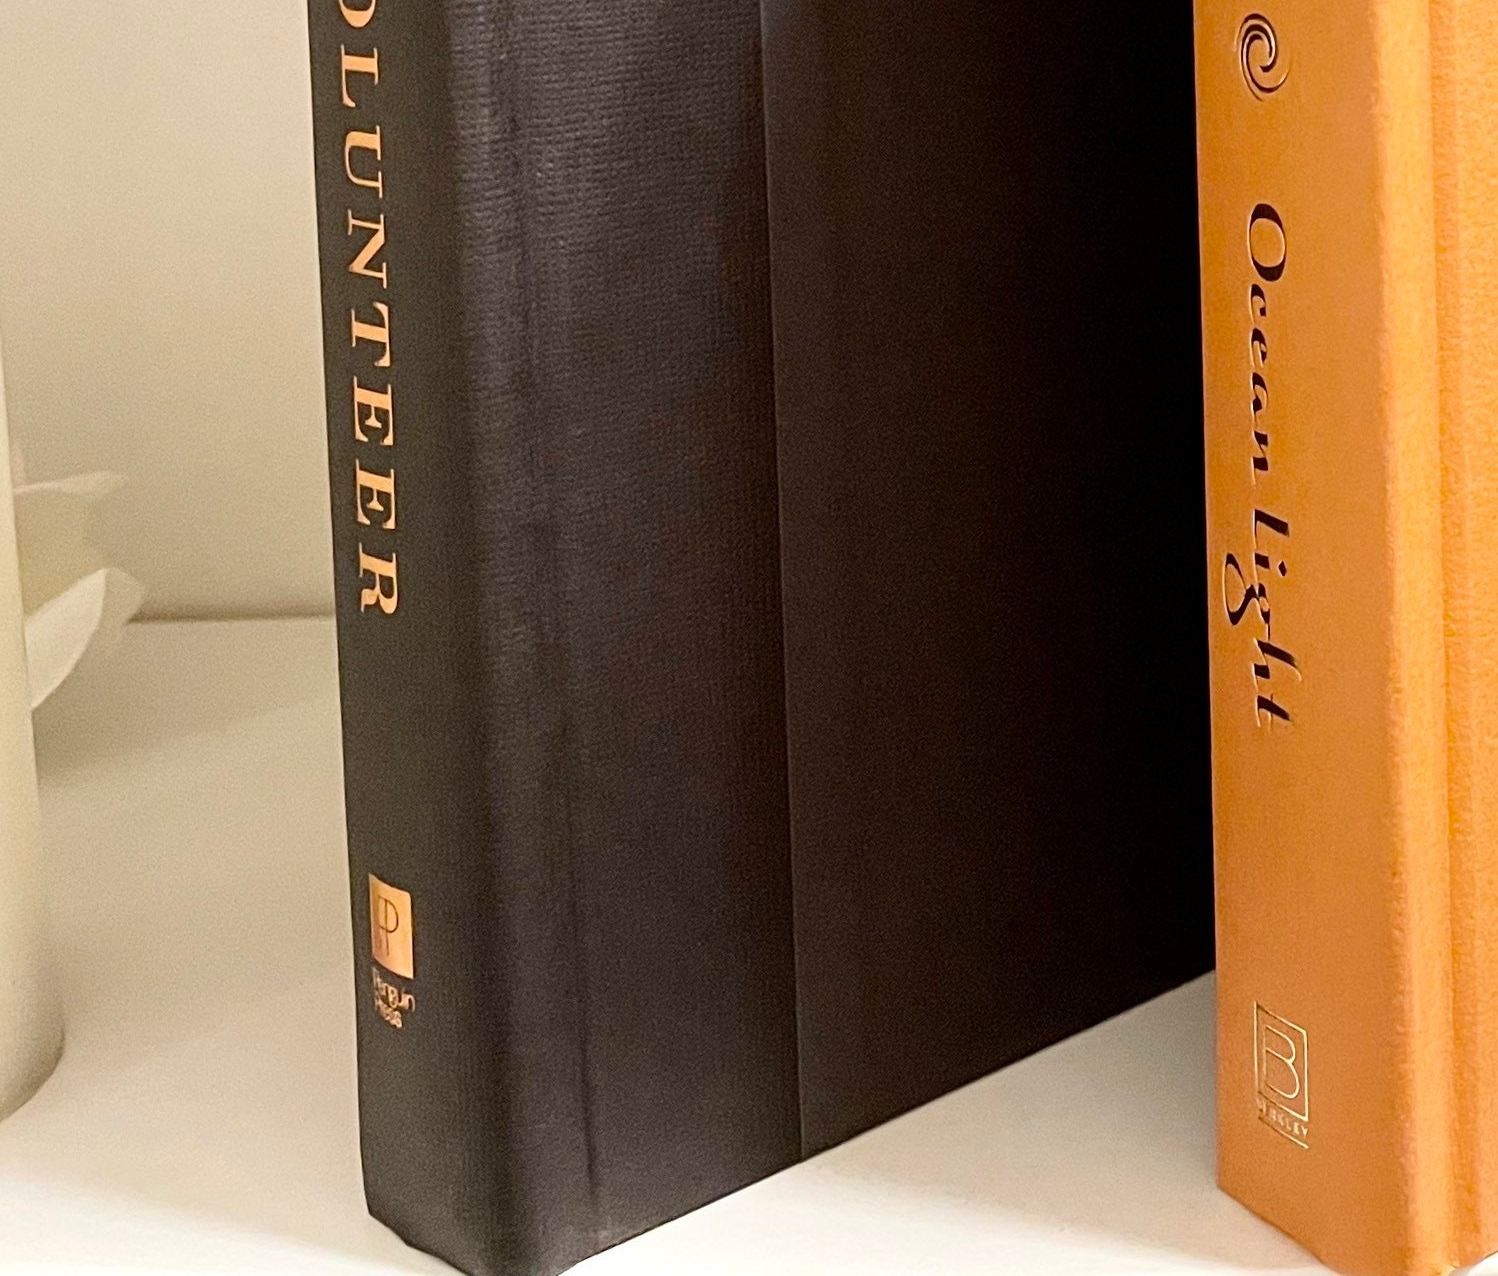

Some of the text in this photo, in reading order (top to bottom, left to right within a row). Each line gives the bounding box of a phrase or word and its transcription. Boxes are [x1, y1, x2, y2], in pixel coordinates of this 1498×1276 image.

[1222, 202, 1303, 729] Ocean Light
[1263, 1025, 1299, 1098] B
